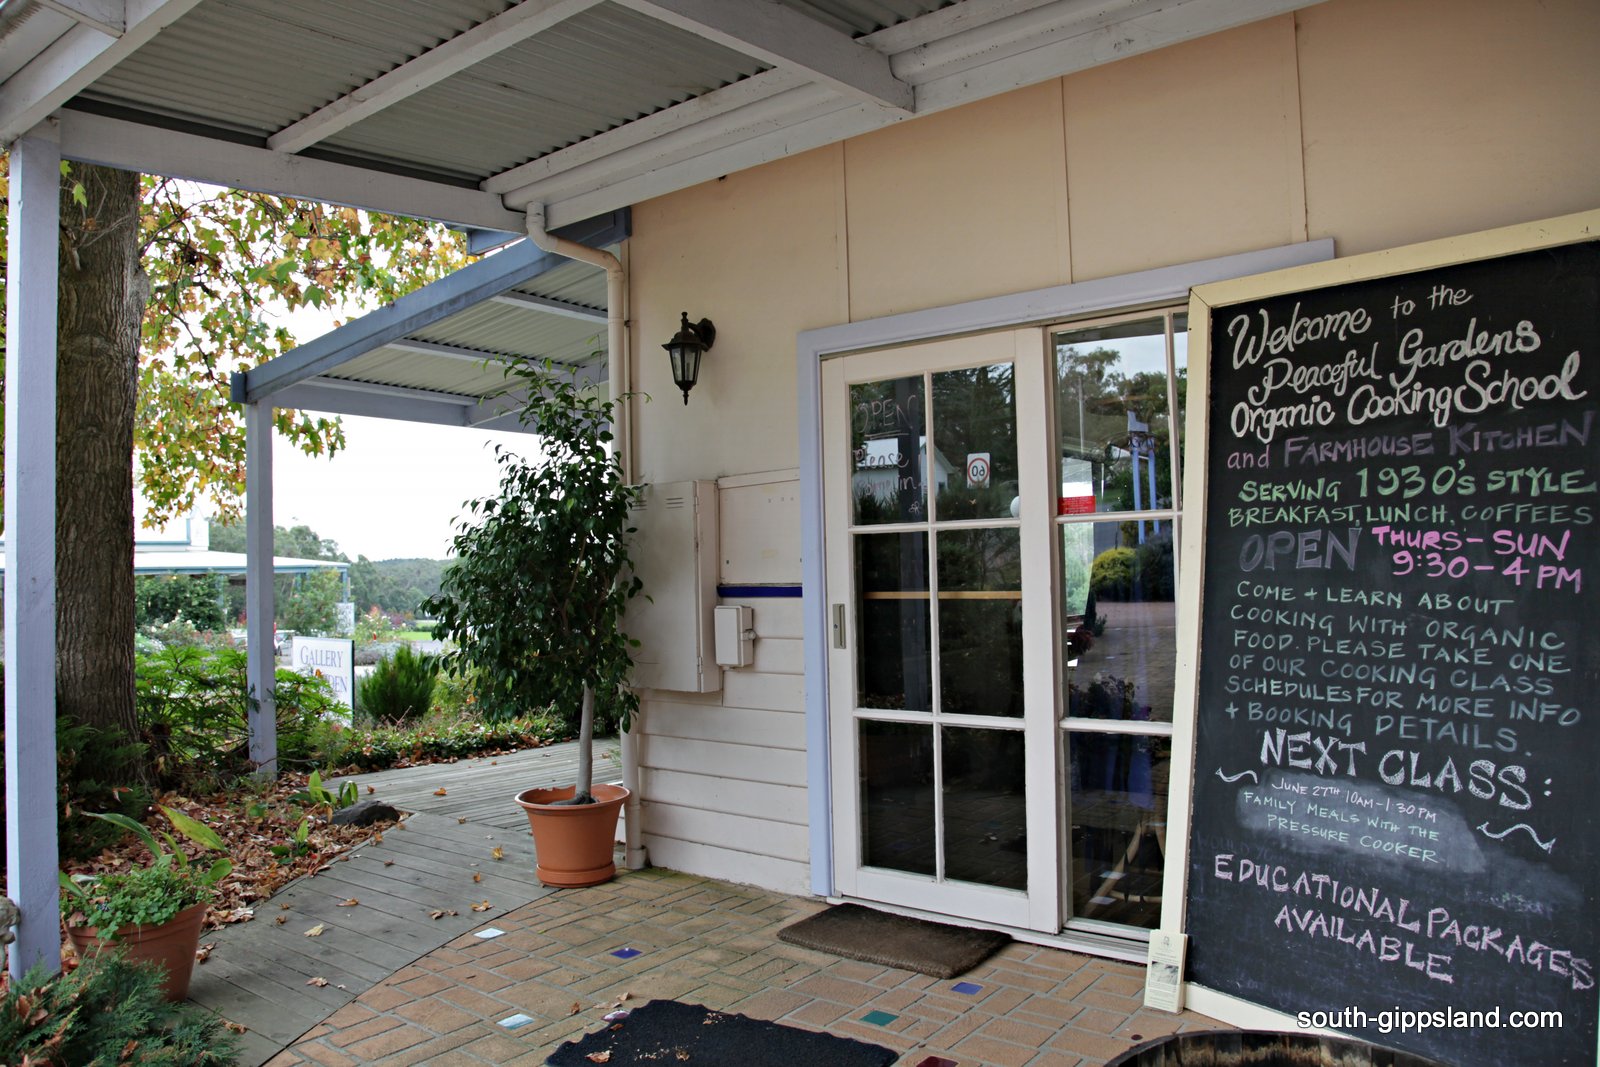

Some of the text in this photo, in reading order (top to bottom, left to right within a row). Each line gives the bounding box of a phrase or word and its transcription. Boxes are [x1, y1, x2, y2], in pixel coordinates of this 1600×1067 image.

[1228, 284, 1474, 370] Welcome to the
[1248, 317, 1542, 406] Peaceful Gardens
[1231, 350, 1588, 443] Organic Cooking School
[1227, 410, 1596, 469] and FARMHOUSE KITCHEN
[1238, 478, 1341, 502] SERVING
[1487, 466, 1597, 497] STYLE
[1461, 503, 1593, 525] COFFEES
[1239, 527, 1363, 572] OPEN
[1237, 581, 1296, 601] COME
[1327, 587, 1402, 609] LEARN
[1418, 592, 1514, 615] ABOUT
[1231, 604, 1565, 649] COOKING WITH ORGANIC
[301, 646, 343, 668] GALLERY
[1229, 654, 1554, 695] OF OUR COOKING CLASS
[1308, 635, 1405, 659] PLEASE
[1418, 643, 1493, 665] TAKE
[1509, 653, 1571, 673] ONE
[1224, 675, 1581, 726] SCHEDULES FOR MORE INFO
[1248, 702, 1352, 736] BOOKING
[1260, 727, 1367, 777] NEXT
[1271, 777, 1309, 795] JUNE
[1243, 791, 1440, 841] FAMILY MEALS WITH THE
[1267, 813, 1440, 863] PRESSURE COOKER
[1214, 854, 1595, 990] EDUCATIONAL PACKAGES
[1274, 904, 1454, 984] AVAILABLE
